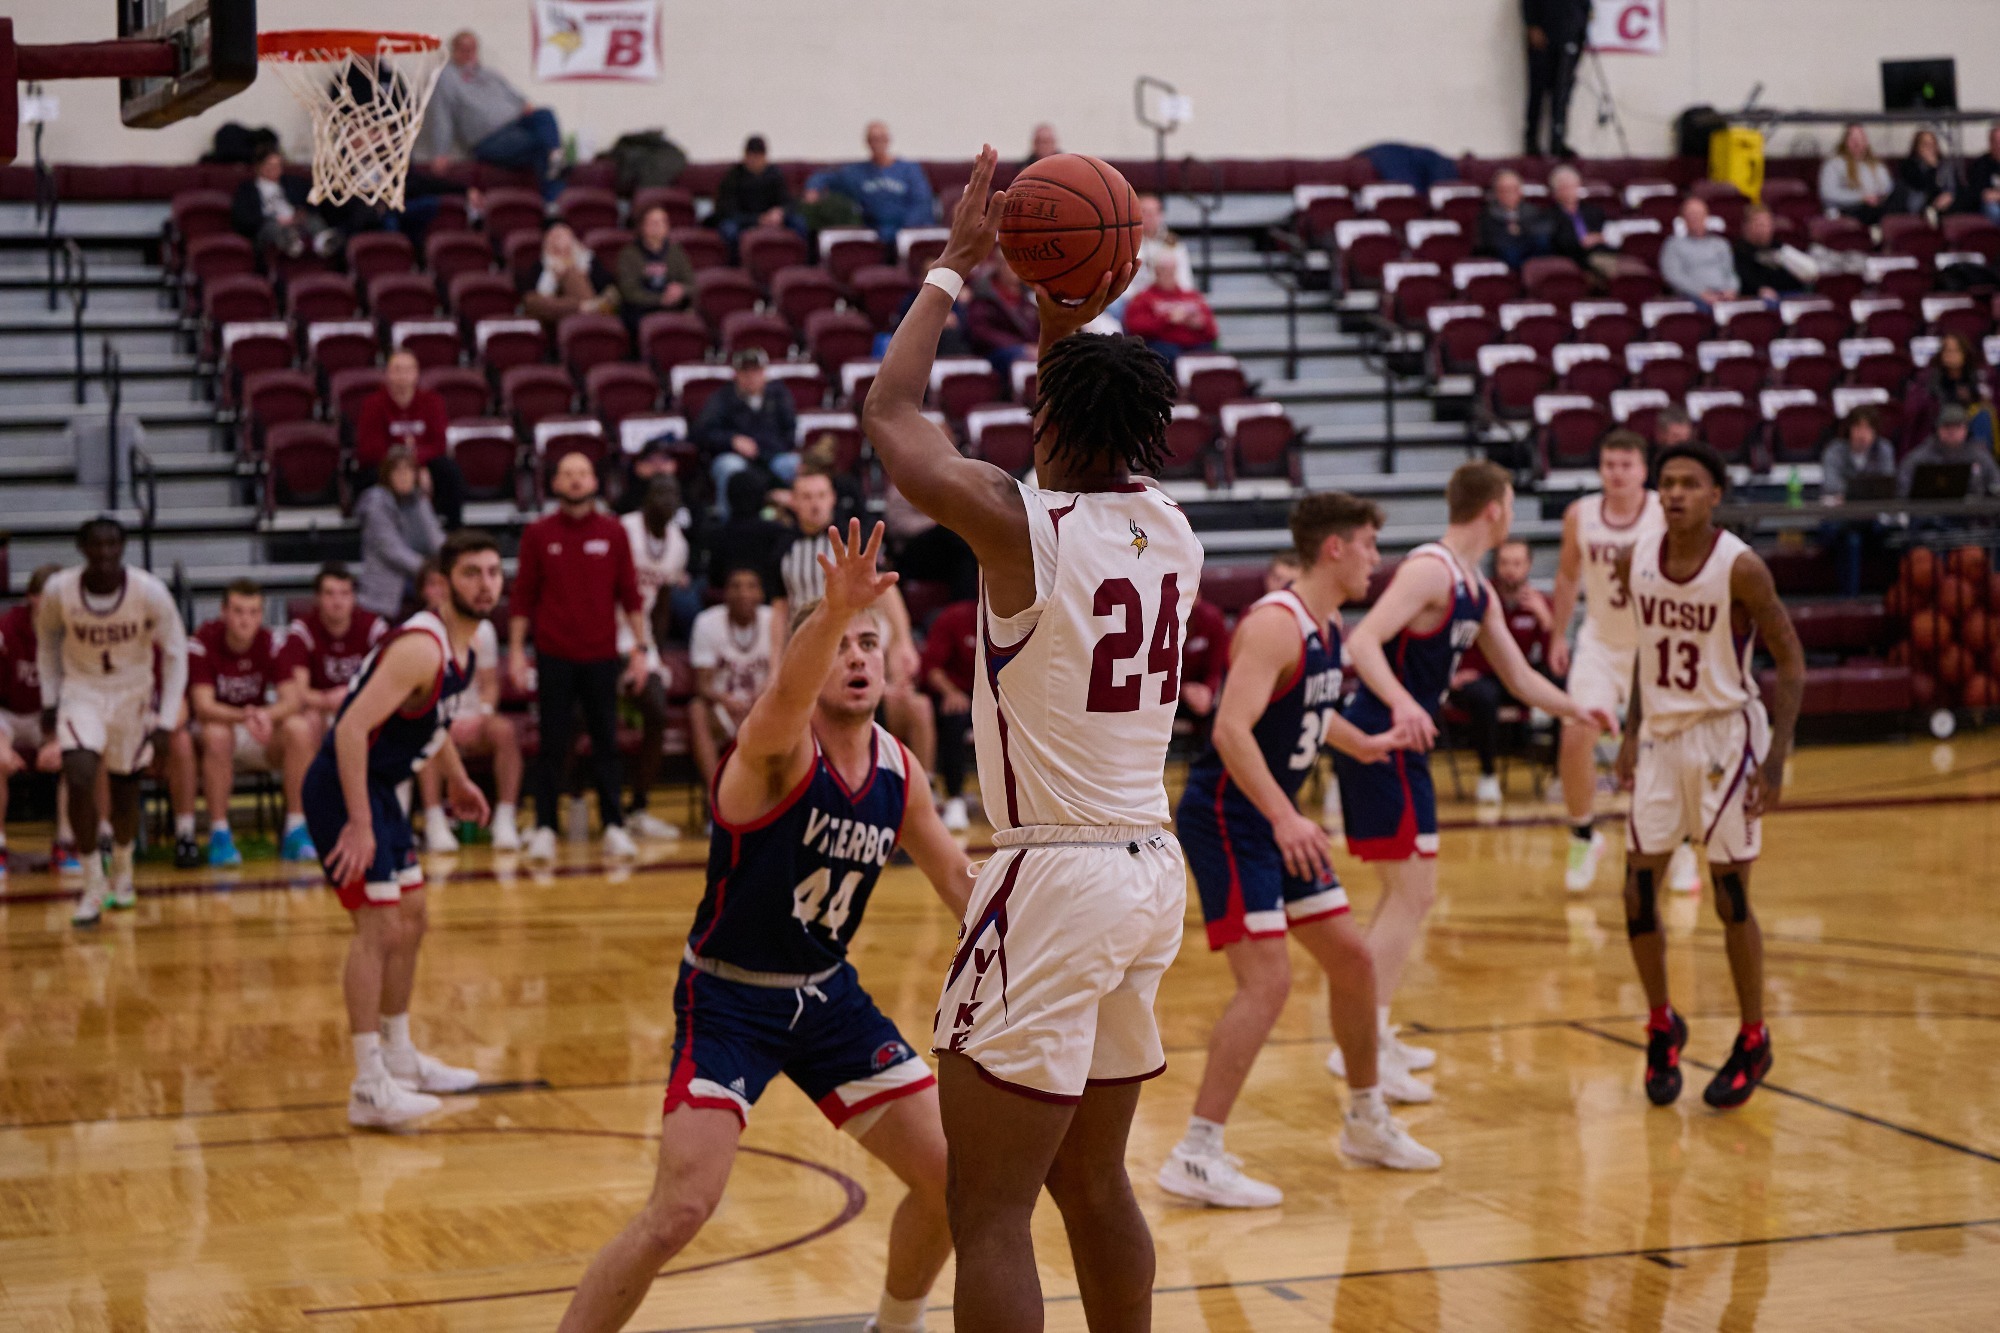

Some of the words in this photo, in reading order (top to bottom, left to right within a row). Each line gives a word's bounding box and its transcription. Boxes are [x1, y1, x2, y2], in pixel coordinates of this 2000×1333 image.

[1618, 6, 1649, 40] C
[606, 29, 643, 66] B
[1640, 595, 1717, 633] VCSU
[1086, 573, 1180, 713] 24
[1655, 636, 1699, 692] 13
[791, 867, 864, 941] 44
